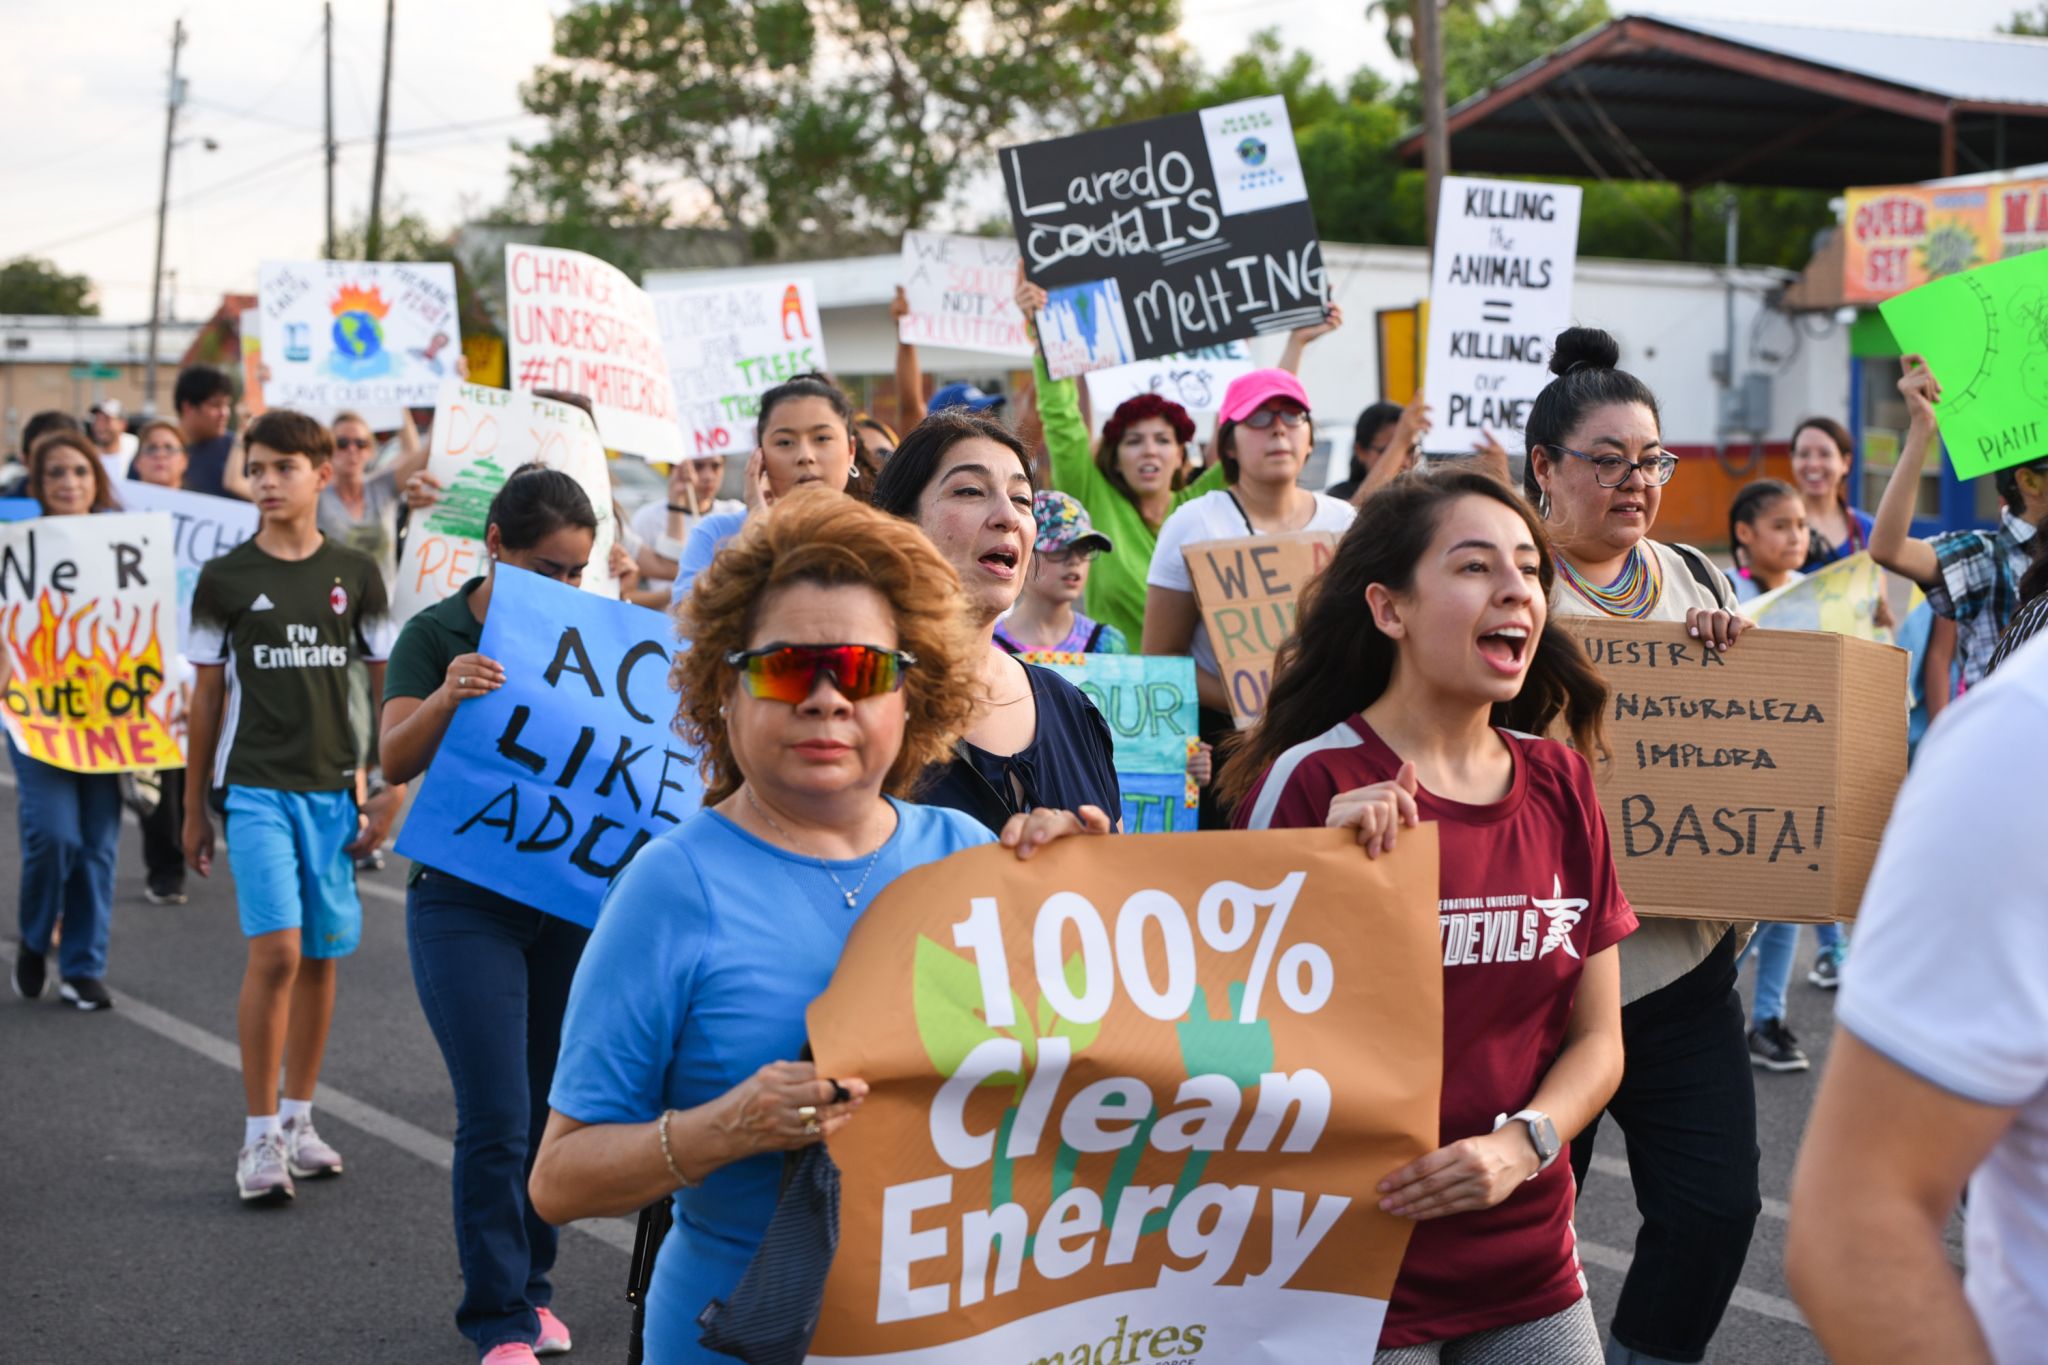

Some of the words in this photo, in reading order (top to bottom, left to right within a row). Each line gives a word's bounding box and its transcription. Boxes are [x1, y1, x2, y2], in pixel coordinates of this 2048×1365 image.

[1010, 140, 1195, 218] Laredo
[1145, 188, 1220, 252] IS
[1464, 187, 1555, 221] KILLING
[944, 264, 1018, 293] SOLUT
[1448, 254, 1553, 289] ANIMALS
[942, 291, 987, 316] NOT
[1449, 331, 1542, 364] KILLING
[375, 384, 440, 401] CLIMAT
[458, 386, 512, 407] HELP
[531, 401, 570, 423] THE
[1448, 394, 1535, 430] PLANE
[693, 426, 731, 454] NO
[170, 510, 243, 566] TCH
[1206, 546, 1292, 600] WE
[286, 624, 318, 645] Fly
[1213, 602, 1297, 659] RU
[253, 644, 348, 670] Emirates
[1584, 637, 1725, 667] UESTRA
[543, 626, 671, 725] AC
[4, 680, 86, 719] out
[1614, 692, 1825, 724] NATURALEZA
[28, 723, 158, 768] TIME
[1636, 740, 1777, 769] IMPLORA
[496, 705, 697, 824] LIKE
[454, 782, 652, 884] ADU
[1621, 794, 1826, 872] BASTA!
[1438, 897, 1485, 912] ERNATIONAL
[1486, 895, 1528, 908] UNIVERSITY
[952, 870, 1335, 1028] 100%
[928, 1036, 1332, 1169] Clean
[876, 1173, 1352, 1324] Energy
